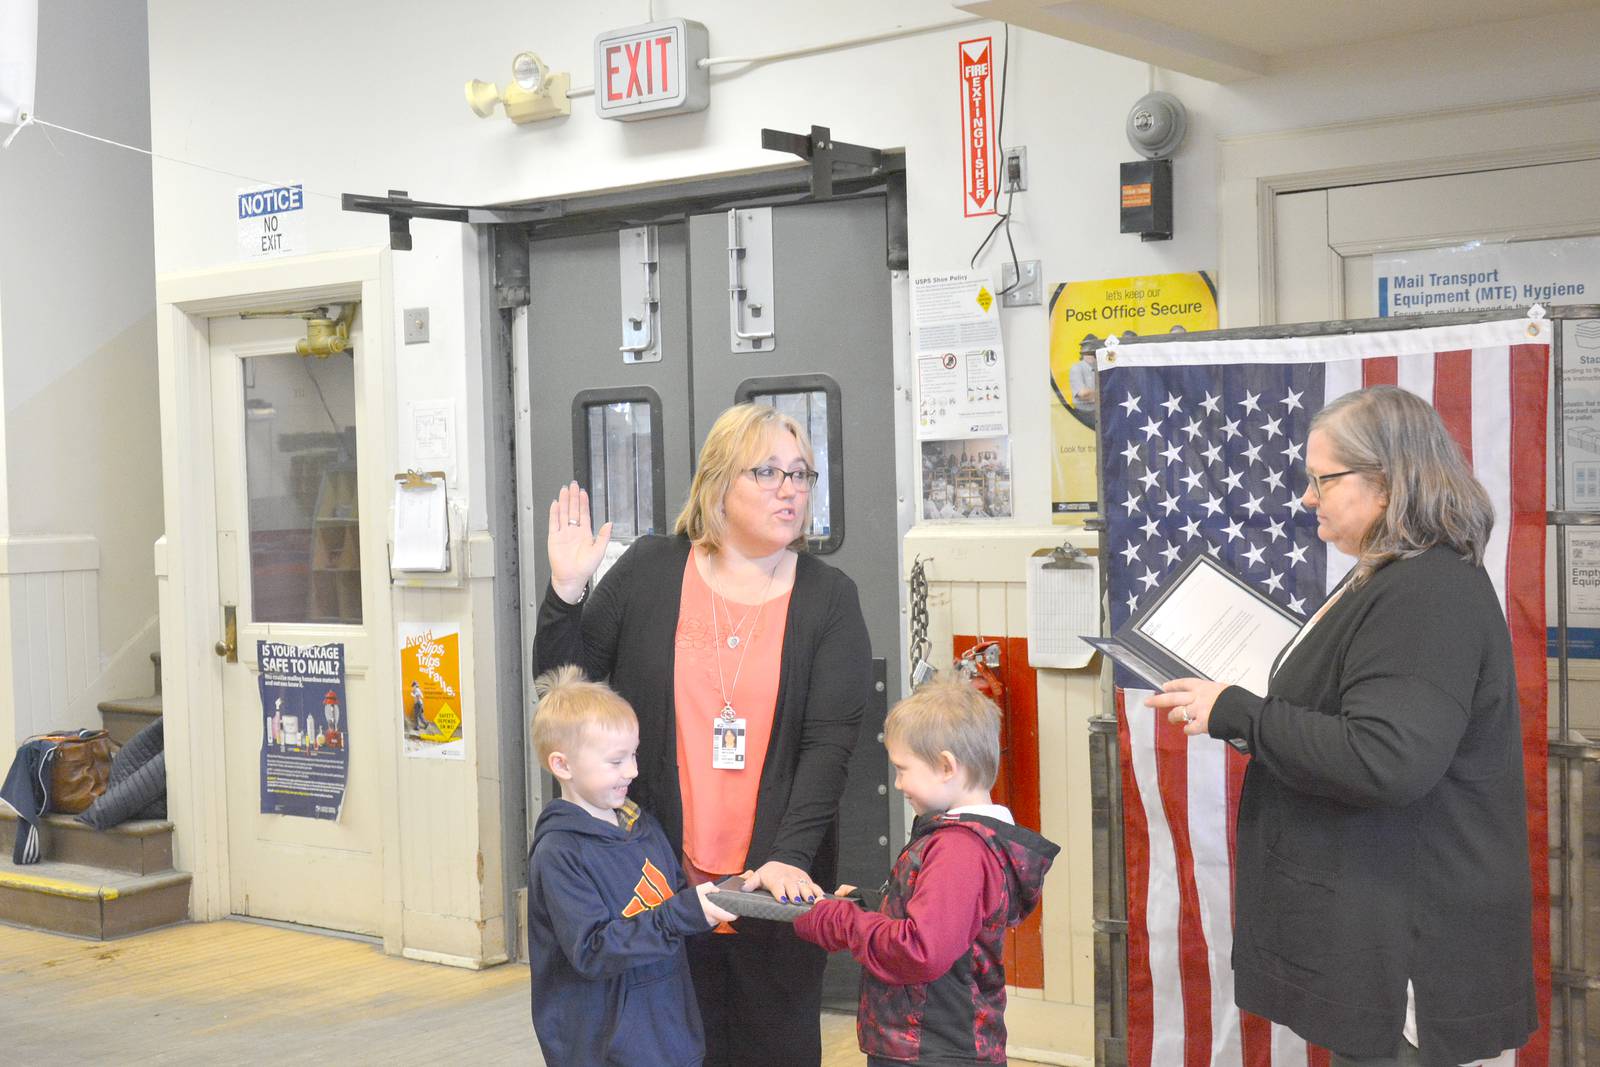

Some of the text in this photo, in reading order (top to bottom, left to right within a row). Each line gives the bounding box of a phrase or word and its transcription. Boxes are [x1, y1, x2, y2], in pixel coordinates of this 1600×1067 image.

[606, 36, 671, 101] EXIT
[965, 64, 987, 78] FIRE
[972, 77, 985, 199] EXTINGUISHER
[241, 189, 299, 216] NOTICE
[264, 215, 278, 232] NO
[261, 233, 282, 251] EXIT
[1394, 269, 1499, 289] Mail Transport
[1105, 289, 1161, 301] let's keep our
[1394, 283, 1585, 308] Equipment (MTE) Hygiene
[1065, 301, 1202, 322] Post Office Secure
[405, 630, 433, 648] Avoid
[262, 644, 340, 659] IS YOUR PACKAGE
[419, 642, 445, 656] Slips,
[262, 658, 340, 675] SAFE TO MAIL?
[416, 653, 440, 668] Trips
[428, 667, 456, 697] Falls.
